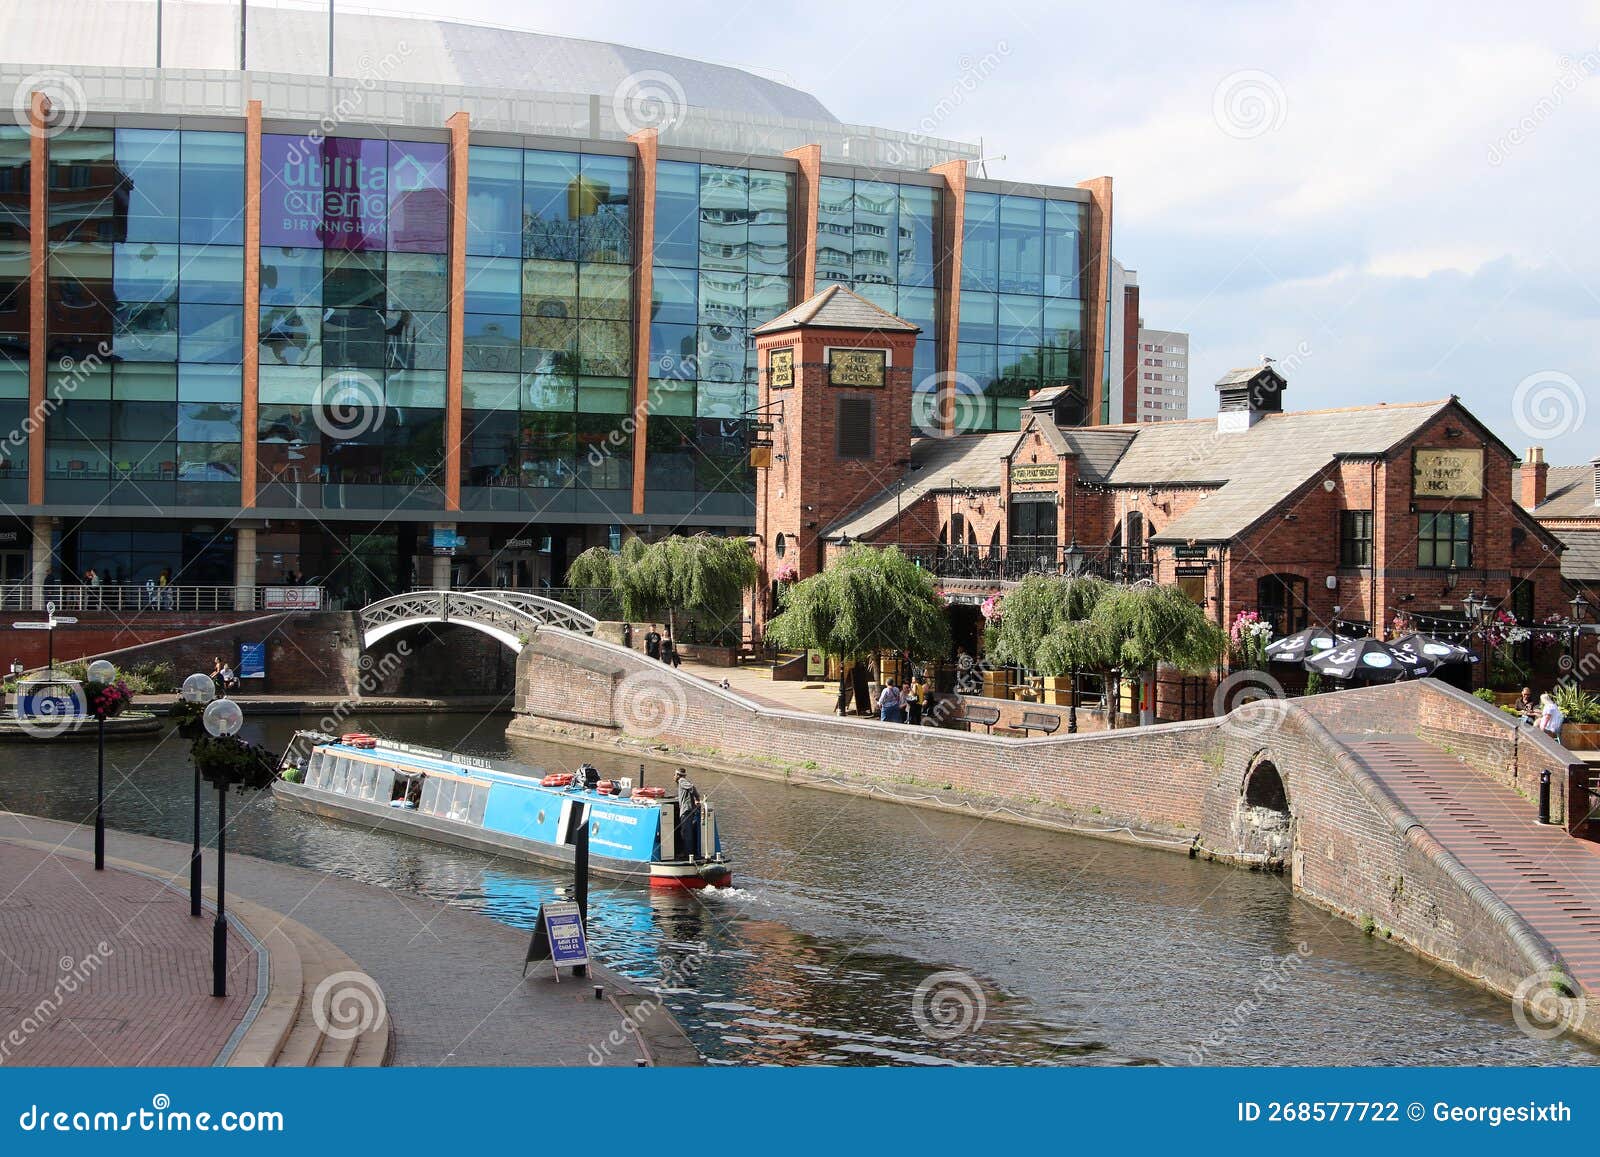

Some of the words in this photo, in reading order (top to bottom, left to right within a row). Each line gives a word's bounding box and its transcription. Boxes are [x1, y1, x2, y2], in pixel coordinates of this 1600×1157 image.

[284, 155, 387, 190] utilita
[284, 190, 388, 219] arena
[283, 218, 390, 234] BIRMINGHAM
